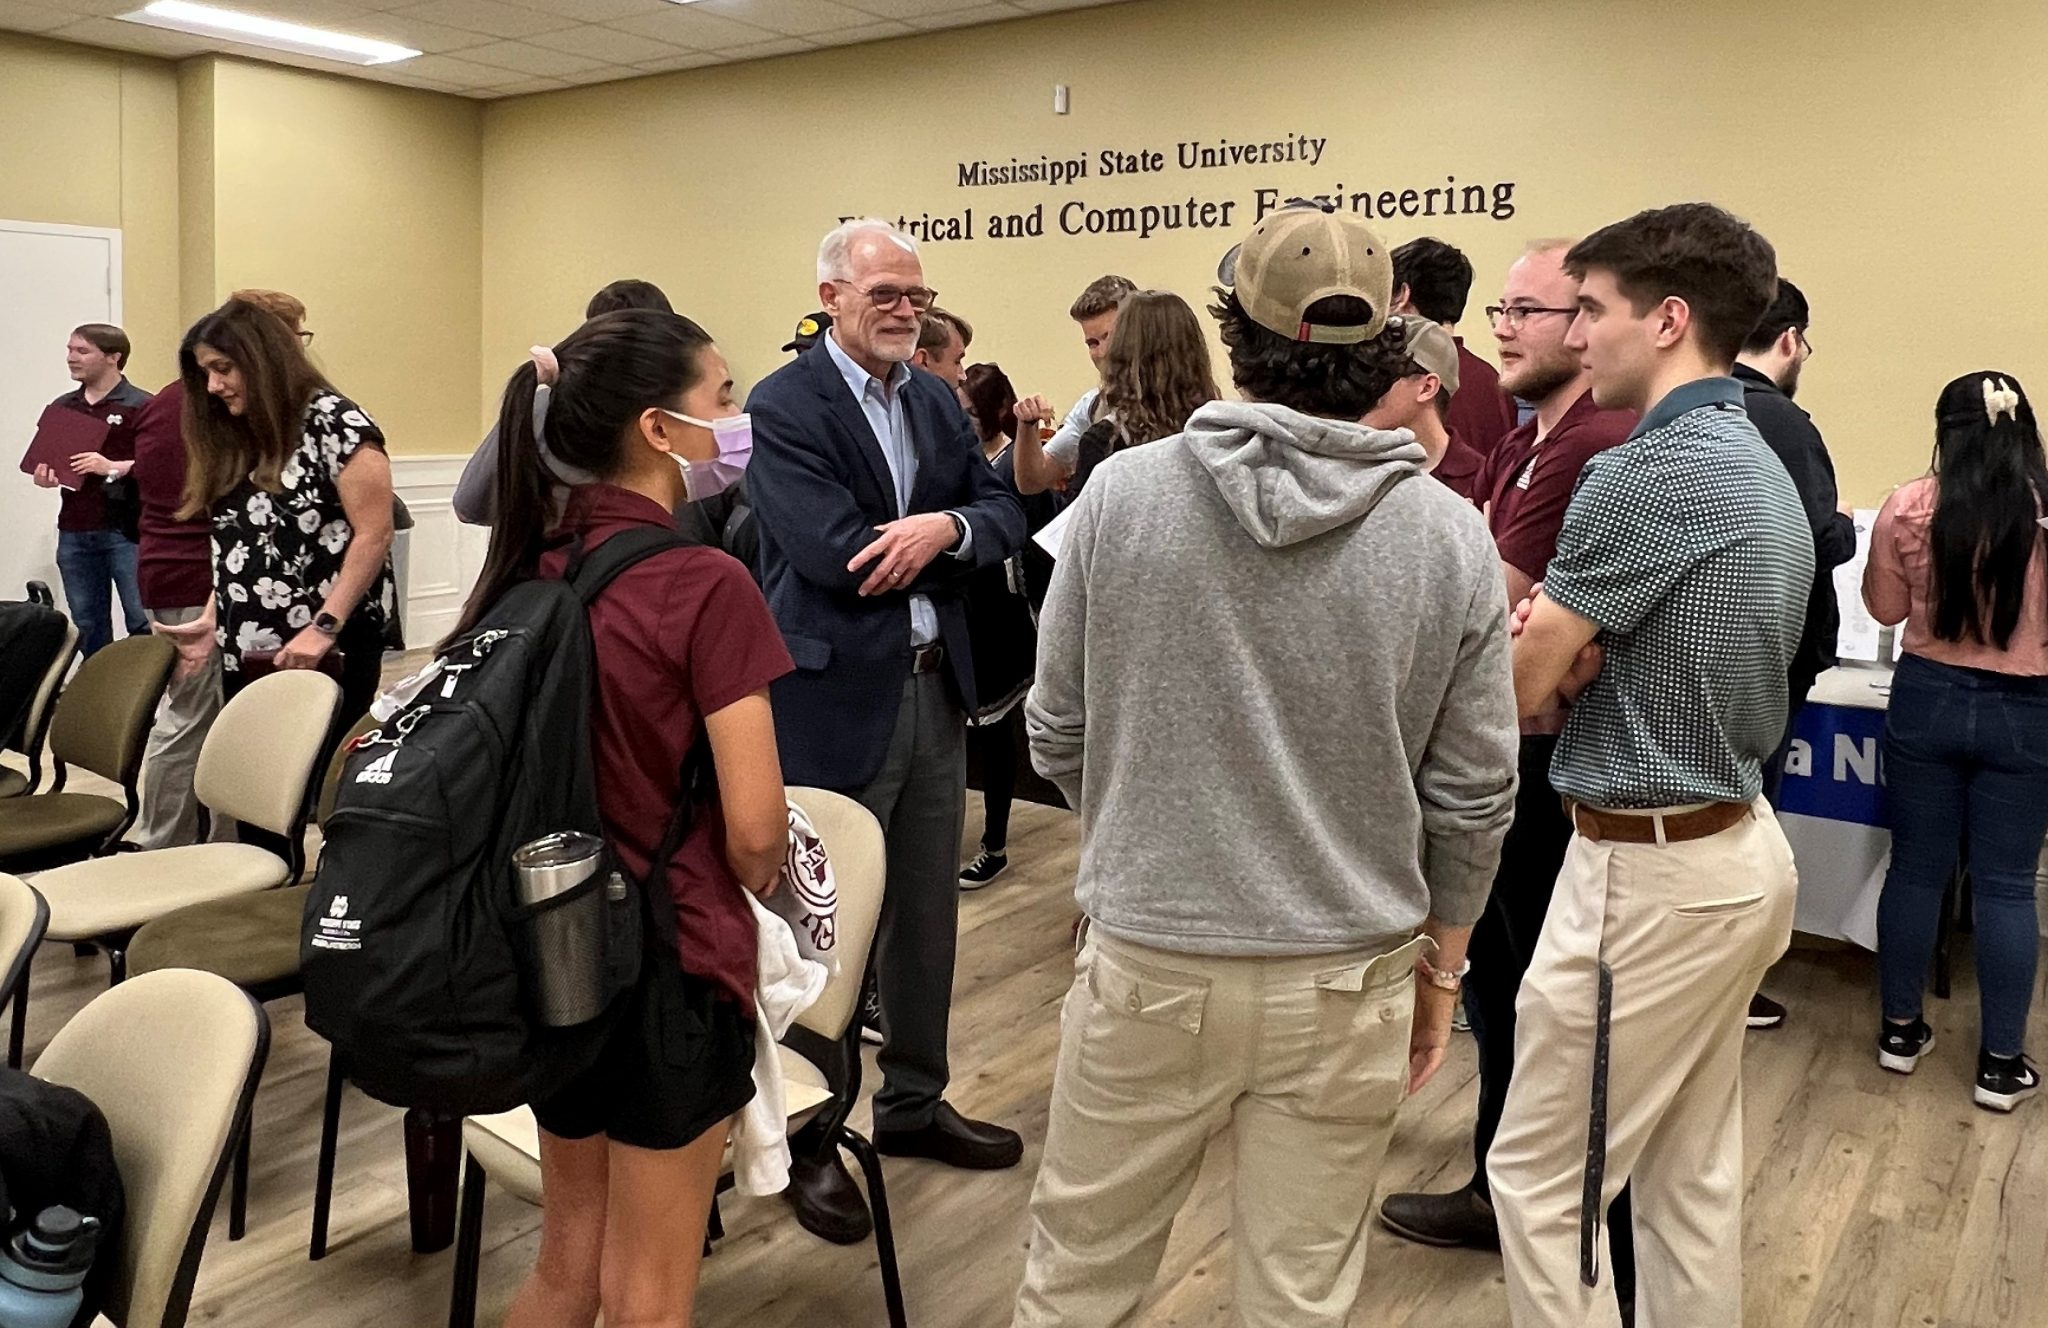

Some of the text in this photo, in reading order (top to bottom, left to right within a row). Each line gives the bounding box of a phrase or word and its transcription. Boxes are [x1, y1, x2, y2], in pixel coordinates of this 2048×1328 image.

[957, 132, 1327, 188] Mississippi State University
[838, 175, 1516, 243] trical and Computer Eineering
[1833, 733, 1887, 787] N
